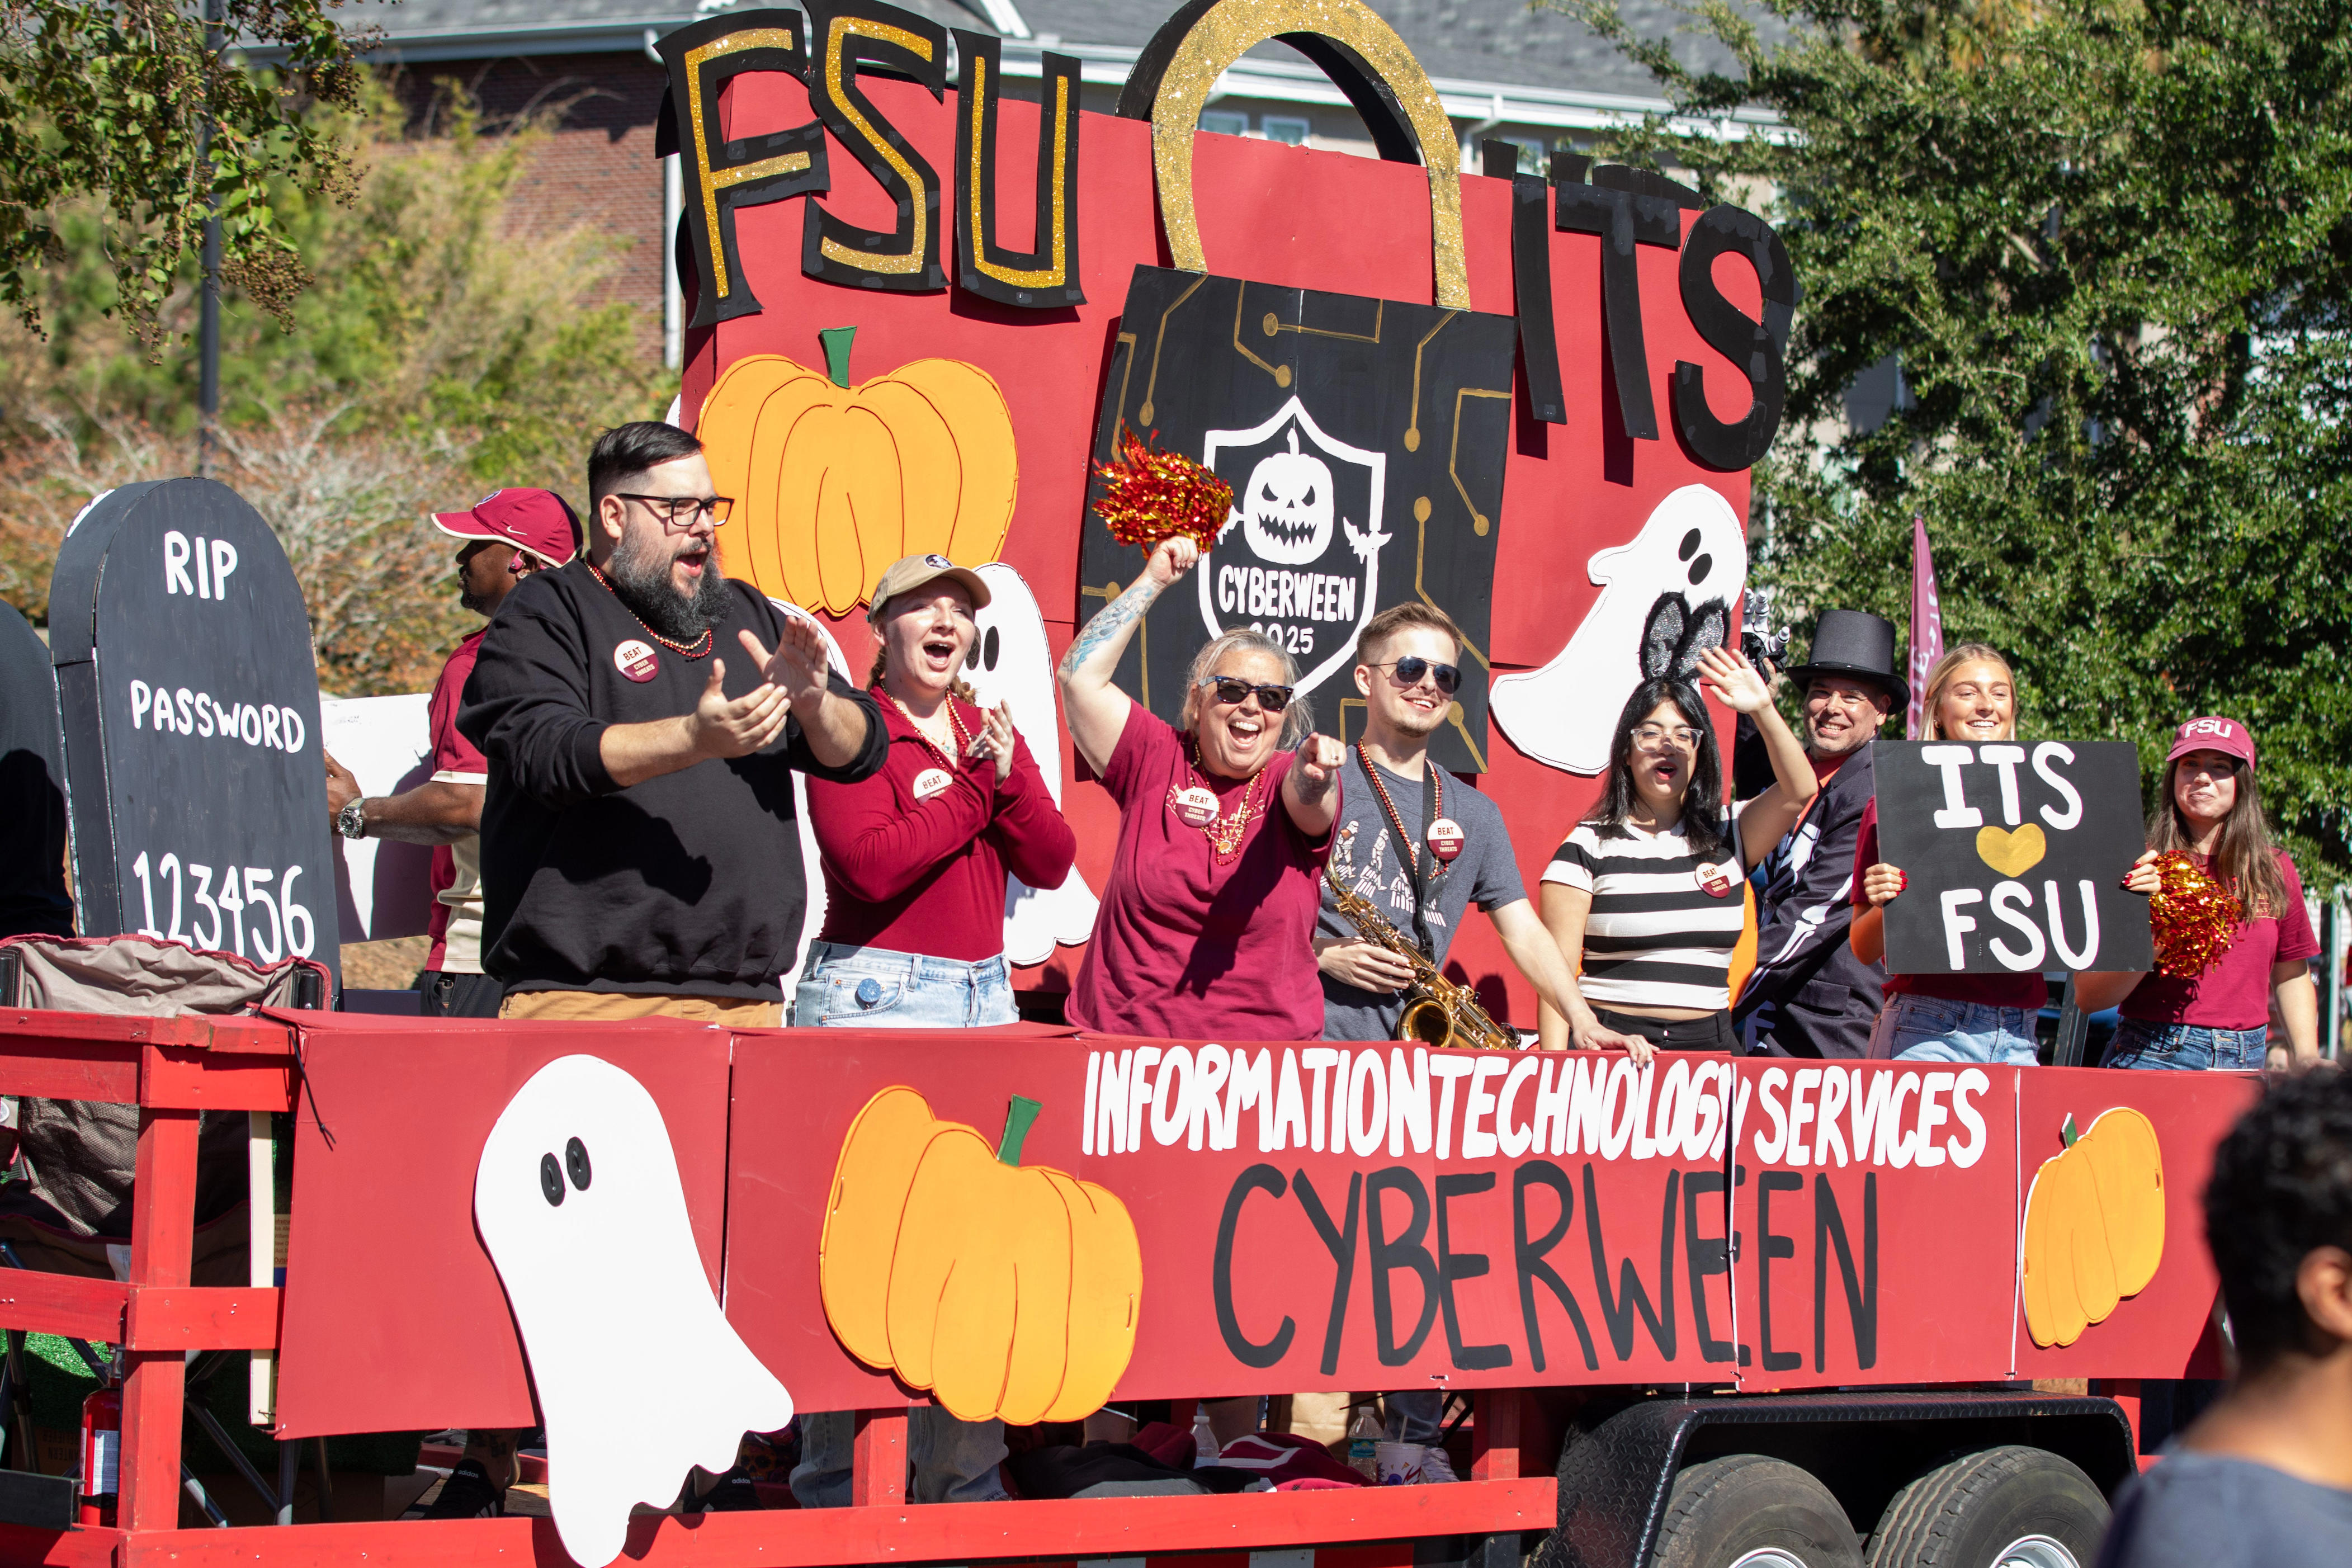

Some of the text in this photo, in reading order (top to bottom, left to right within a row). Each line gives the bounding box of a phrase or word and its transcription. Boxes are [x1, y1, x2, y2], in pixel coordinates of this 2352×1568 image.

[653, 0, 1796, 470] FSU ITS
[164, 531, 238, 601] RIP
[1218, 565, 1356, 622] CYBERWEEN
[623, 647, 642, 661] BEAT
[131, 679, 305, 753] PASSWORD
[2185, 719, 2232, 738] FSU
[922, 775, 941, 789] BEAT
[1189, 794, 1210, 805] BEAT
[1921, 741, 2083, 831] ITS
[1184, 812, 1206, 821] THREATS
[1703, 868, 1717, 878] BEAT
[133, 851, 315, 964] 123456
[1940, 880, 2100, 971] FSU
[1754, 1065, 1990, 1169] SERVICES
[1213, 1160, 1878, 1375] CYBERWEEN
[458, 1469, 479, 1479] adidas
